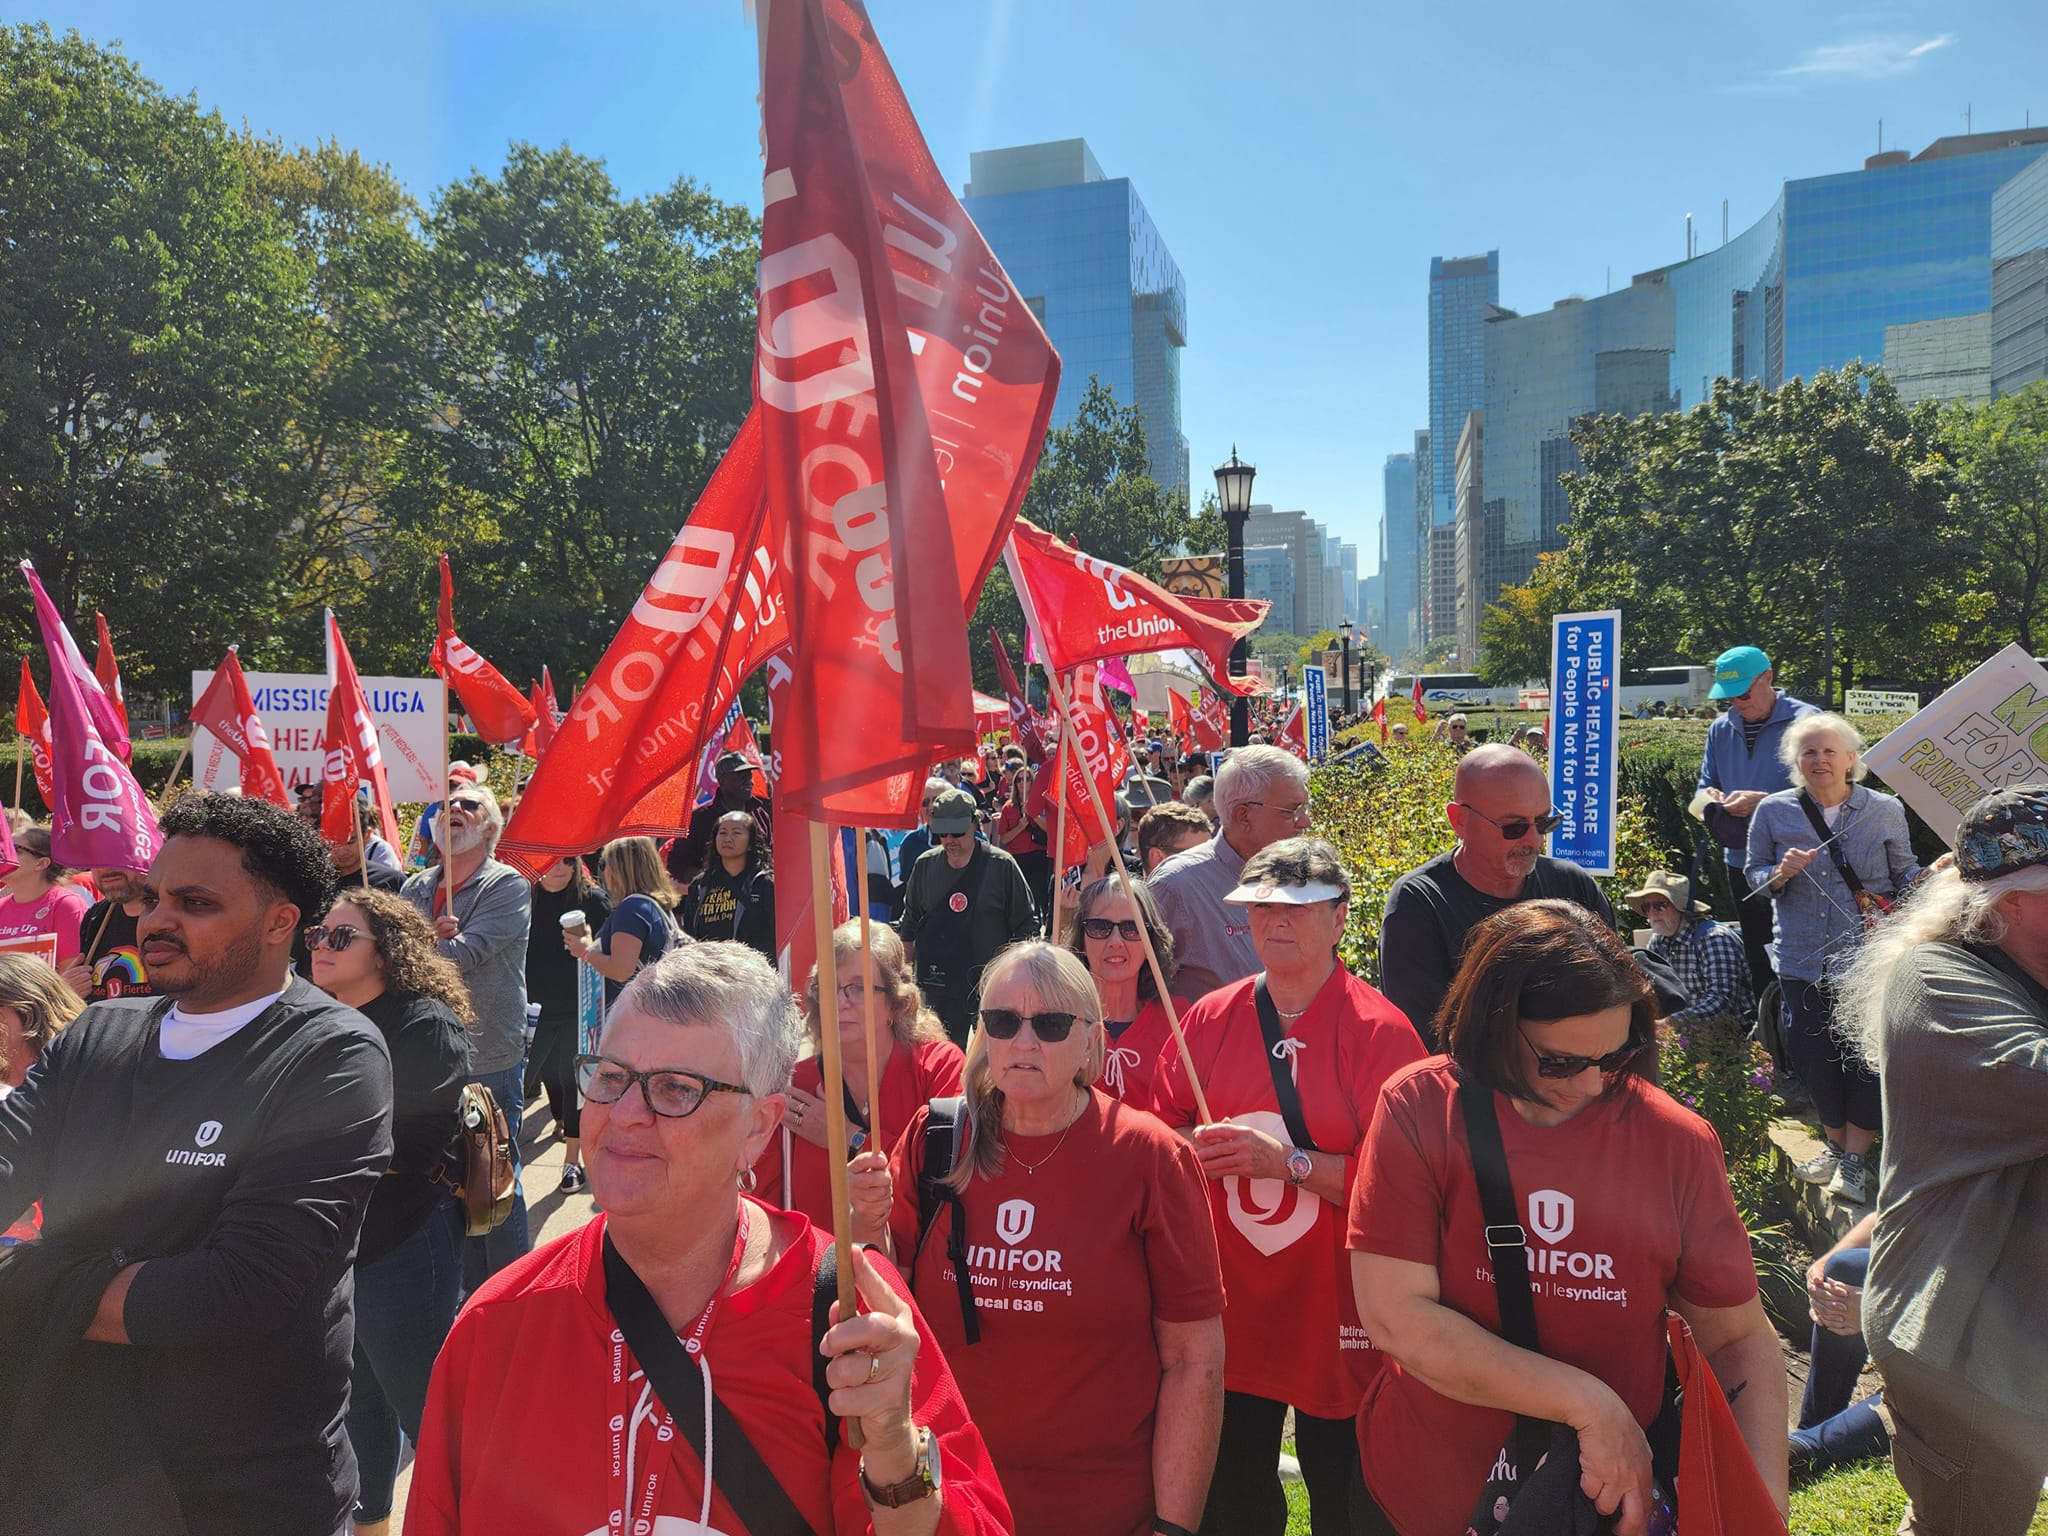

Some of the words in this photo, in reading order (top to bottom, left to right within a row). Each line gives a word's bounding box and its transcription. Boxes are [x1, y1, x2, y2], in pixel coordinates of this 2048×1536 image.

[1567, 626, 1582, 651] for
[1586, 632, 1602, 700] PUBLIC
[1562, 656, 1581, 718] People
[1563, 722, 1579, 755] Not
[1585, 705, 1601, 777] HEALTH
[1944, 712, 2048, 789] FOR
[1562, 760, 1578, 785] for
[1898, 738, 1989, 817] PRIVATI
[1561, 789, 1577, 841] Profit
[1584, 782, 1599, 835] CARE
[1555, 848, 1581, 857] Ontario
[1583, 849, 1606, 858] Health
[165, 1150, 227, 1167] UNIFOR
[943, 1269, 998, 1287] thenion
[1009, 1277, 1072, 1293] lesyndicat
[1524, 1246, 1616, 1280] NIFOR
[974, 1297, 1009, 1310] ocal
[1013, 1299, 1044, 1312] 636
[1554, 1283, 1627, 1302] lesyndicat
[613, 1344, 622, 1383] UNIFOR
[612, 1434, 621, 1477] UNIFOR
[641, 1473, 658, 1517] UNIFOR
